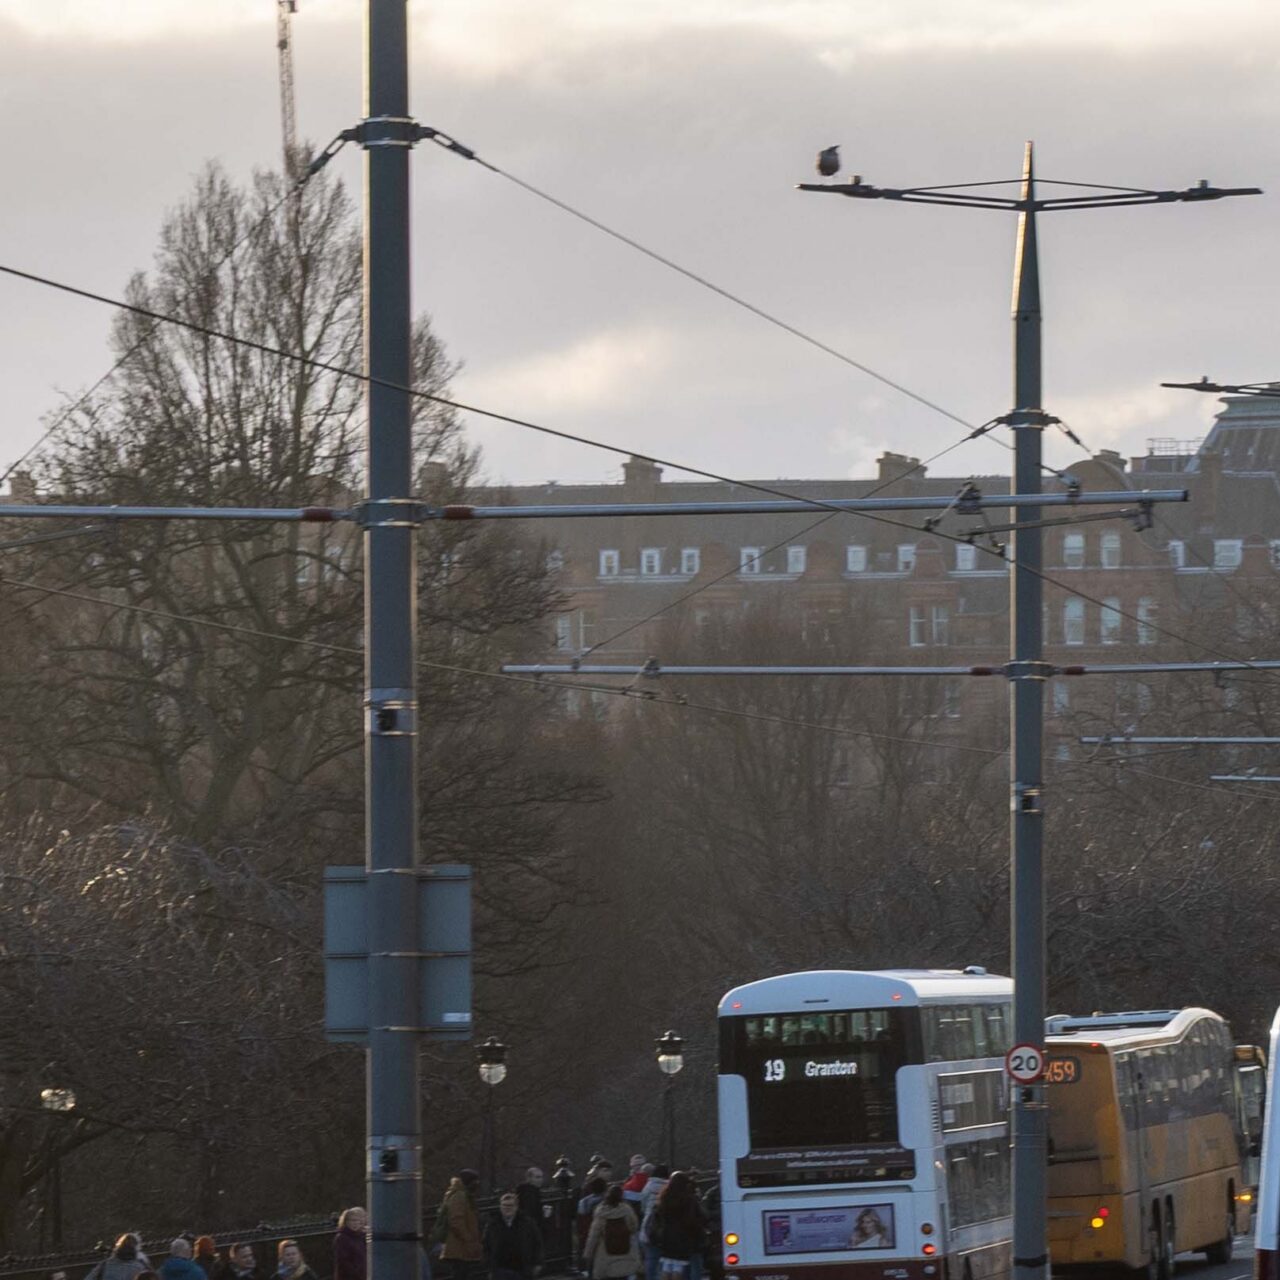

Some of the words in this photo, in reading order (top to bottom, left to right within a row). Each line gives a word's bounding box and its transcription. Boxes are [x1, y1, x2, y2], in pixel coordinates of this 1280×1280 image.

[764, 1059, 785, 1082] 19
[804, 1059, 857, 1078] Granton
[1011, 1055, 1039, 1072] 20
